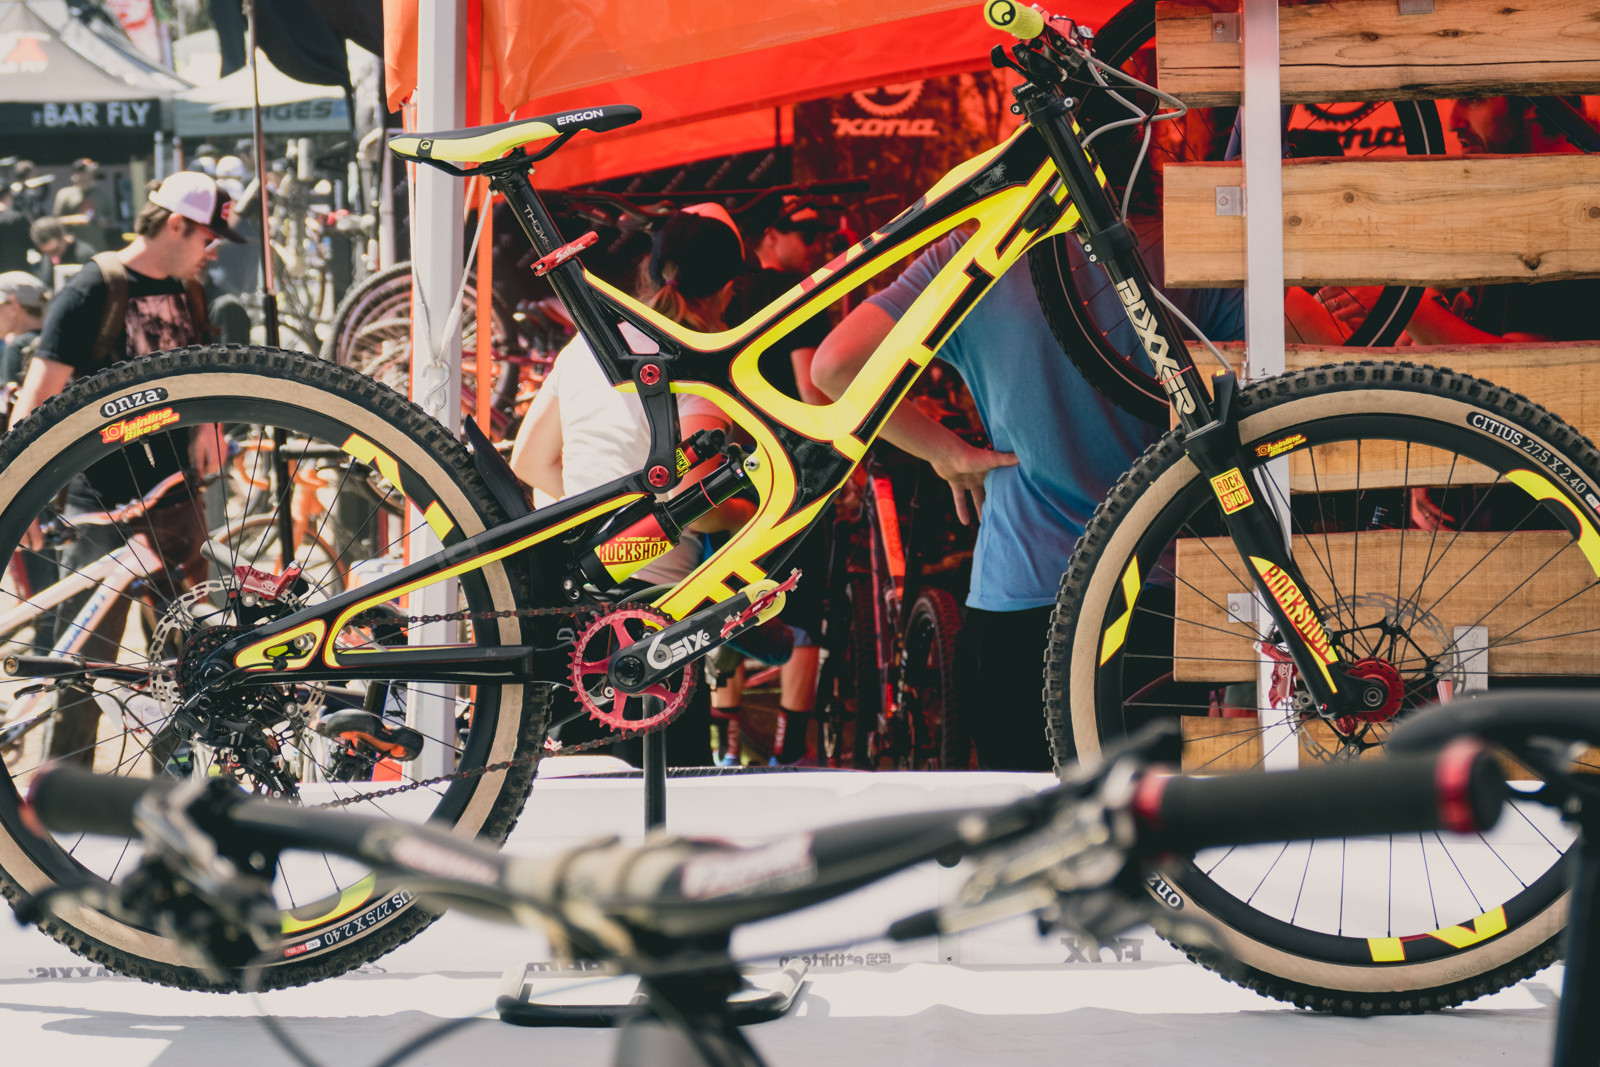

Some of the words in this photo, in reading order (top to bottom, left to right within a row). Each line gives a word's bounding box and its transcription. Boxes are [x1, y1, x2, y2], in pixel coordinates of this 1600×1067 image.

[43, 102, 99, 127] BAR
[107, 102, 150, 127] FLY
[556, 109, 604, 126] ERGON
[1116, 277, 1196, 415] BOXXER
[104, 389, 161, 416] onza
[1472, 414, 1524, 446] CITIUS
[1523, 439, 1551, 463] 27.5
[1559, 467, 1587, 494] 2.40
[1216, 473, 1242, 494] ROCK
[1223, 488, 1250, 509] SHOX
[600, 542, 667, 561] ROCKSHOX
[1262, 564, 1332, 655] ROCKSHOX
[324, 925, 353, 946] 2.40
